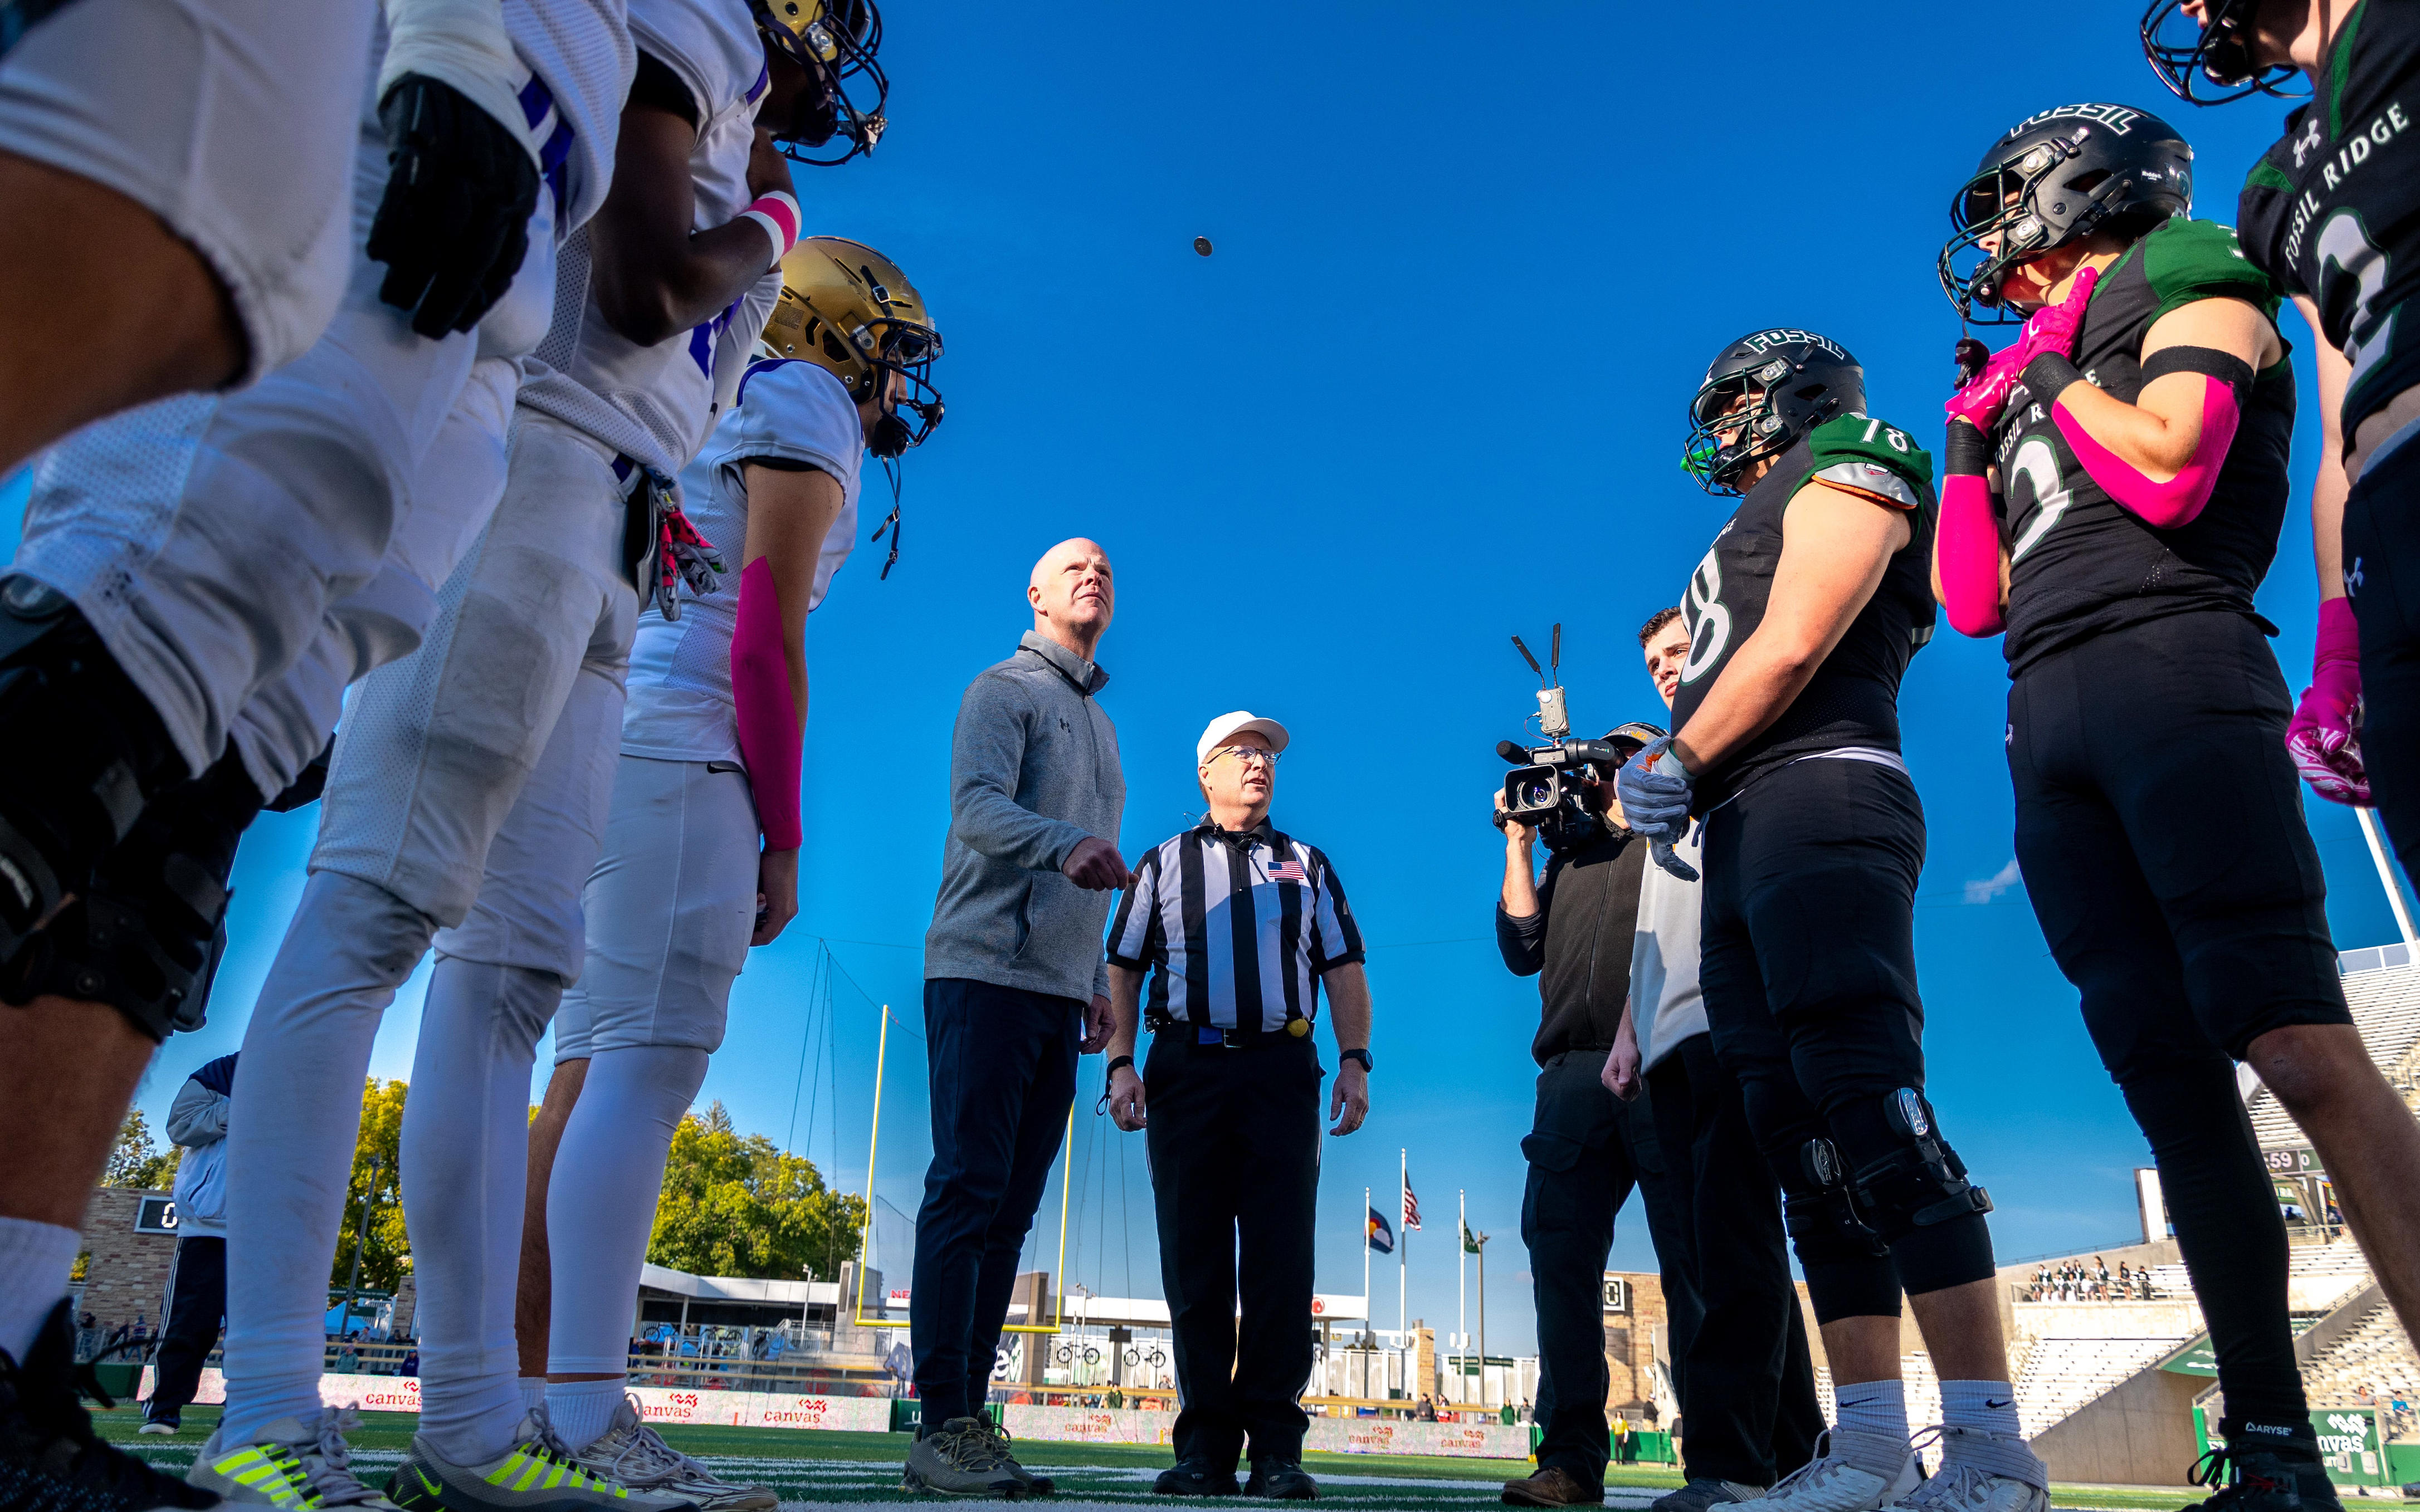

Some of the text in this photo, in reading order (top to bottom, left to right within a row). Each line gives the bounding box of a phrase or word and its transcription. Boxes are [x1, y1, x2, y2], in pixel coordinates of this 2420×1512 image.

[2285, 101, 2409, 271] FOSSIL RIDGE
[1743, 329, 1845, 360] FOSSIL
[1858, 416, 1910, 454] 78
[1680, 545, 1733, 687] 8
[1605, 1281, 1619, 1305] 0
[764, 1411, 820, 1423] canvas
[1065, 1422, 1108, 1433] canvas
[2316, 1435, 2365, 1453] nvas
